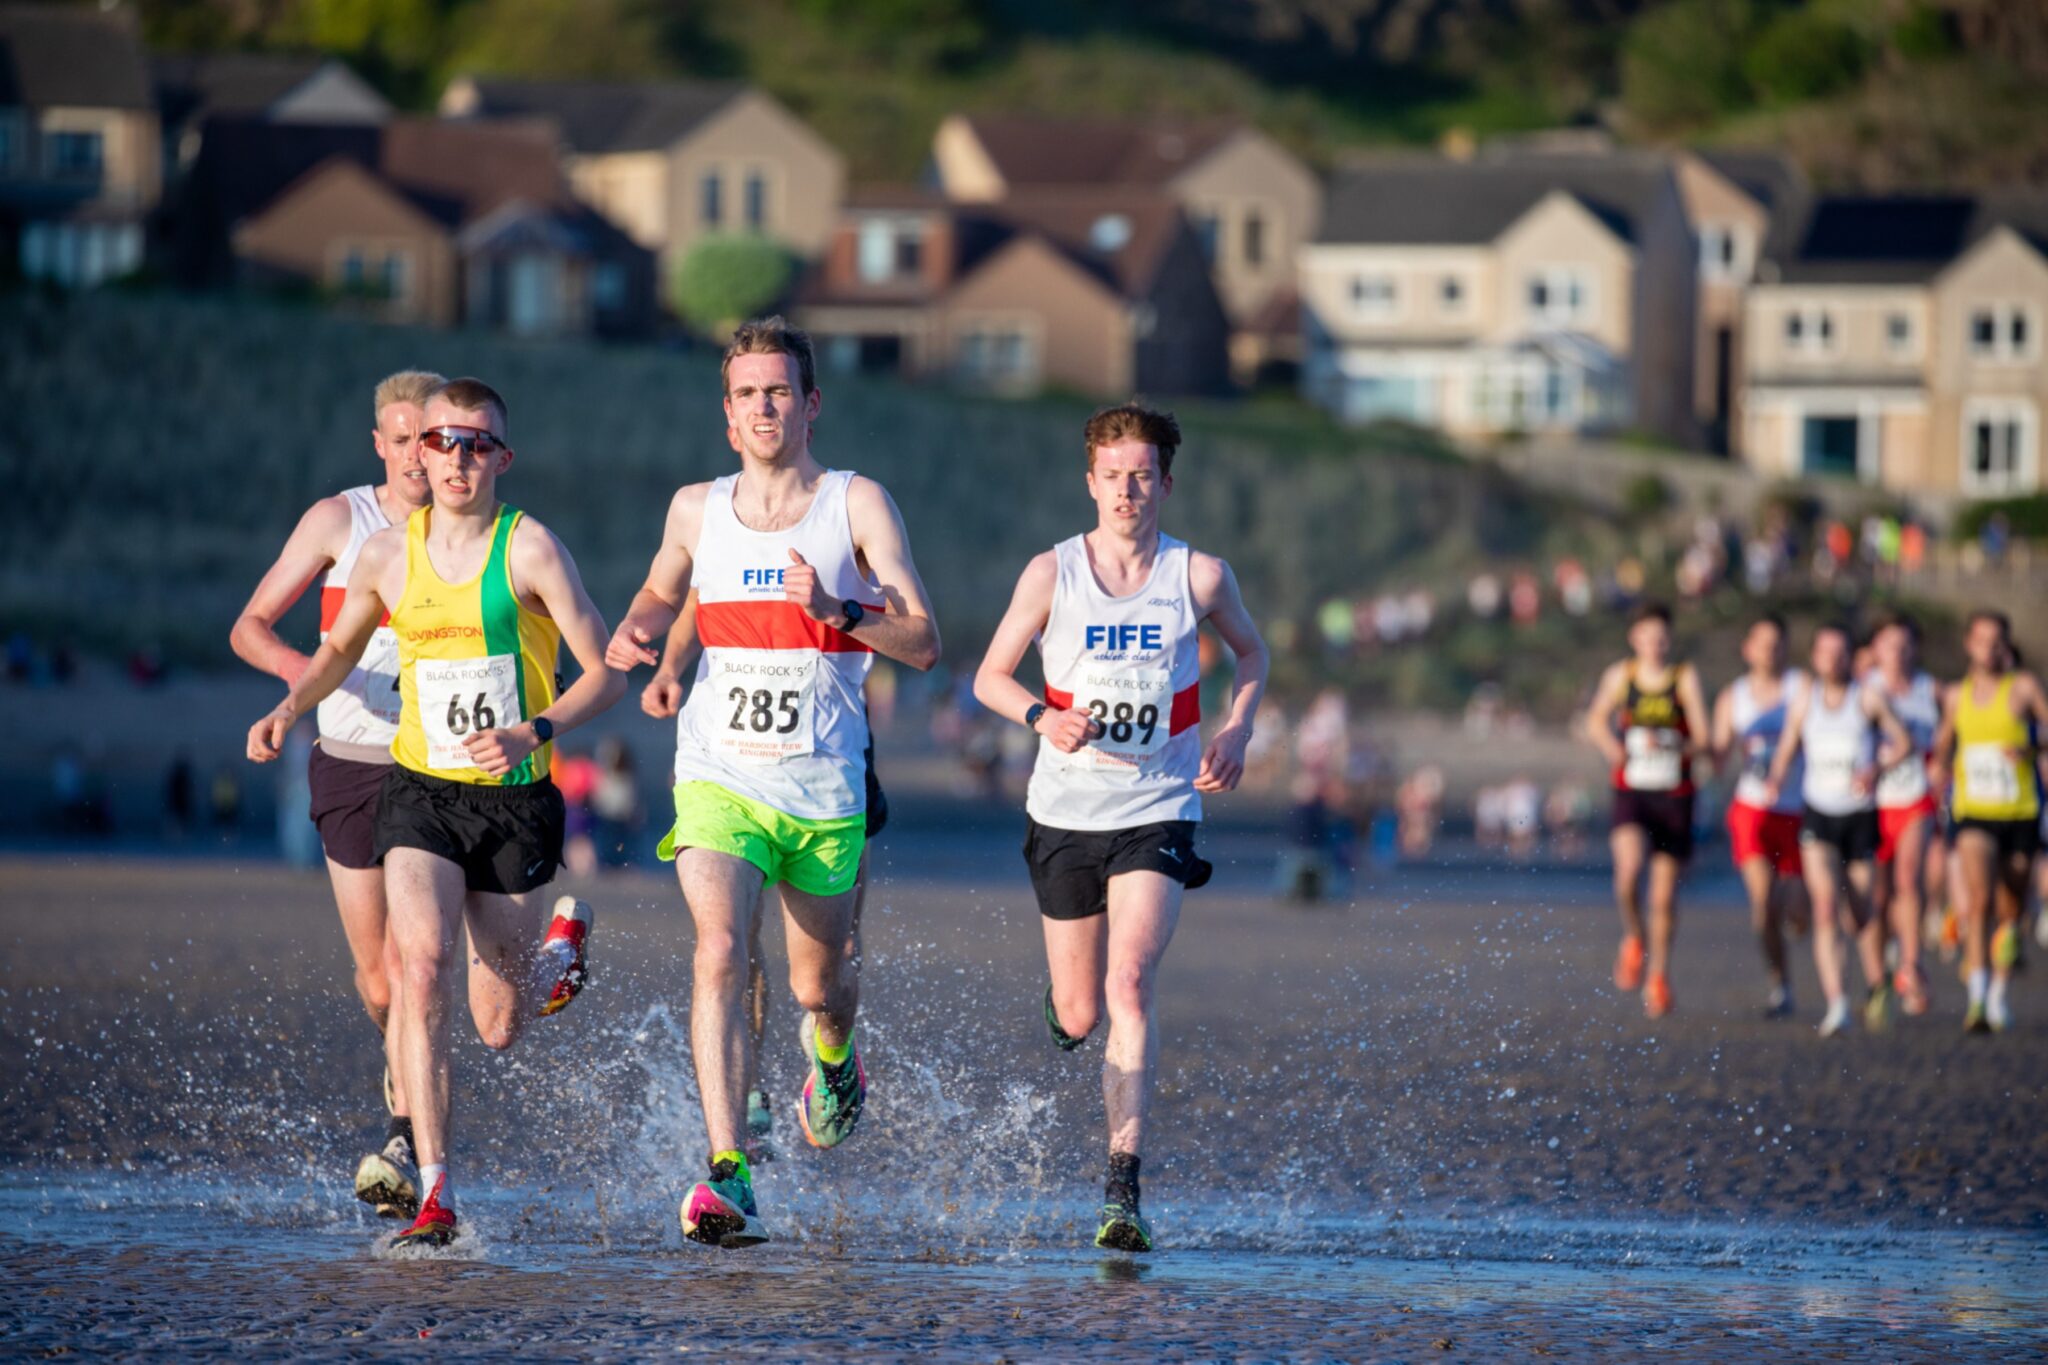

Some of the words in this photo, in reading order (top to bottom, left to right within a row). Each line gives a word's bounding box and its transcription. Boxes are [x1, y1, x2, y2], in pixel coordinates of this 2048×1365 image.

[743, 569, 786, 585] FIFE
[407, 626, 482, 642] LIVINGSTON
[1086, 624, 1162, 650] FIFE
[379, 640, 399, 648] BLA
[1094, 651, 1128, 661] athletic
[1132, 651, 1151, 661] club
[426, 669, 458, 681] BLACK
[461, 667, 491, 680] ROCK
[724, 662, 756, 674] BLACK
[760, 665, 791, 677] ROCK
[1087, 674, 1120, 688] BLACK
[1123, 679, 1152, 691] ROCK
[447, 692, 495, 735] 66
[728, 686, 800, 734] 285
[1089, 699, 1159, 745] 389
